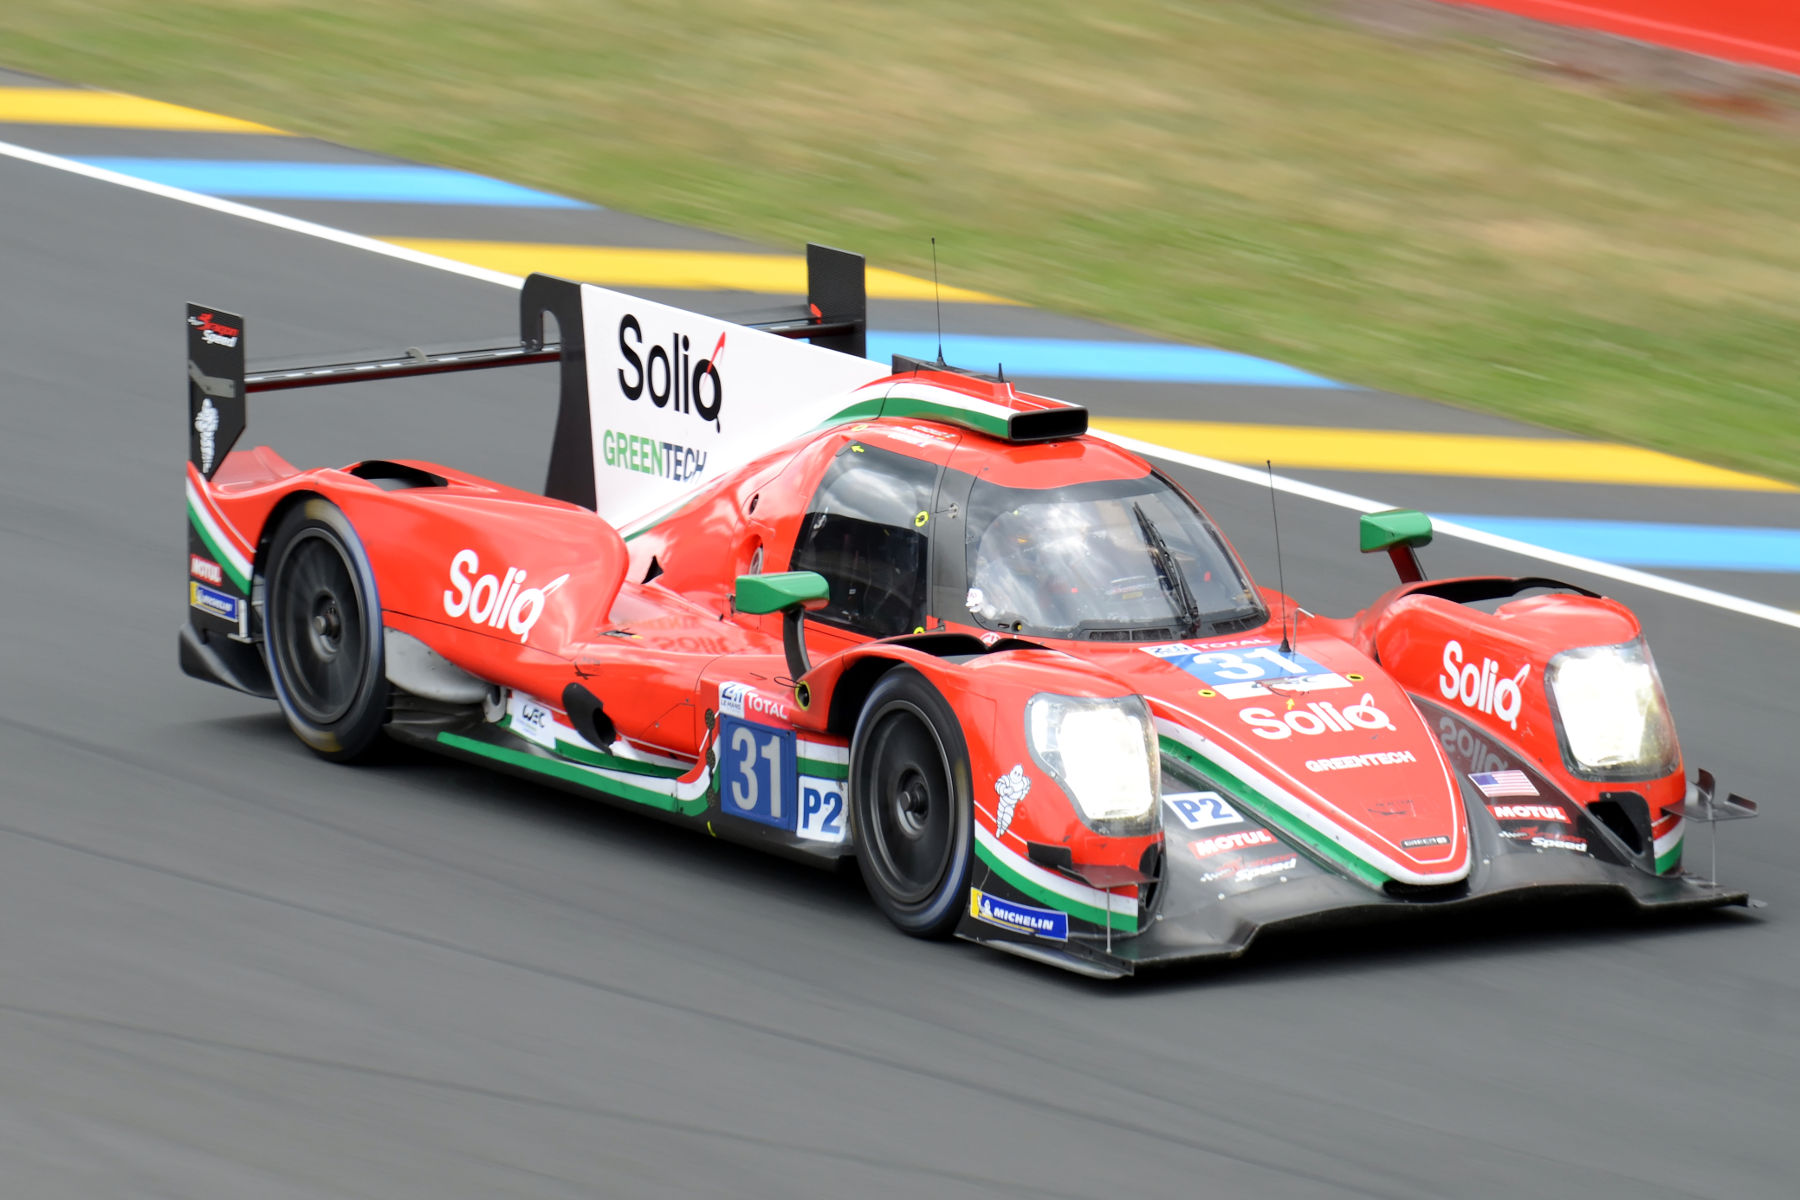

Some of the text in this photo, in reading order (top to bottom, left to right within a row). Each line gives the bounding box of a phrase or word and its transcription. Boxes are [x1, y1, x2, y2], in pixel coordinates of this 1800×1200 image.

[603, 429, 707, 482] GREENTECH
[1192, 638, 1272, 650] TOTAL
[1193, 647, 1308, 680] 31
[747, 692, 788, 719] TOTAL
[731, 727, 782, 819] 31
[1305, 750, 1417, 773] GREENTECH
[802, 787, 843, 834] P2
[1172, 798, 1233, 823] P2
[1493, 806, 1567, 820] MOTUL
[1195, 830, 1273, 857] MOTUL
[1530, 836, 1588, 852] Speed
[993, 907, 1054, 931] MICHELIN
